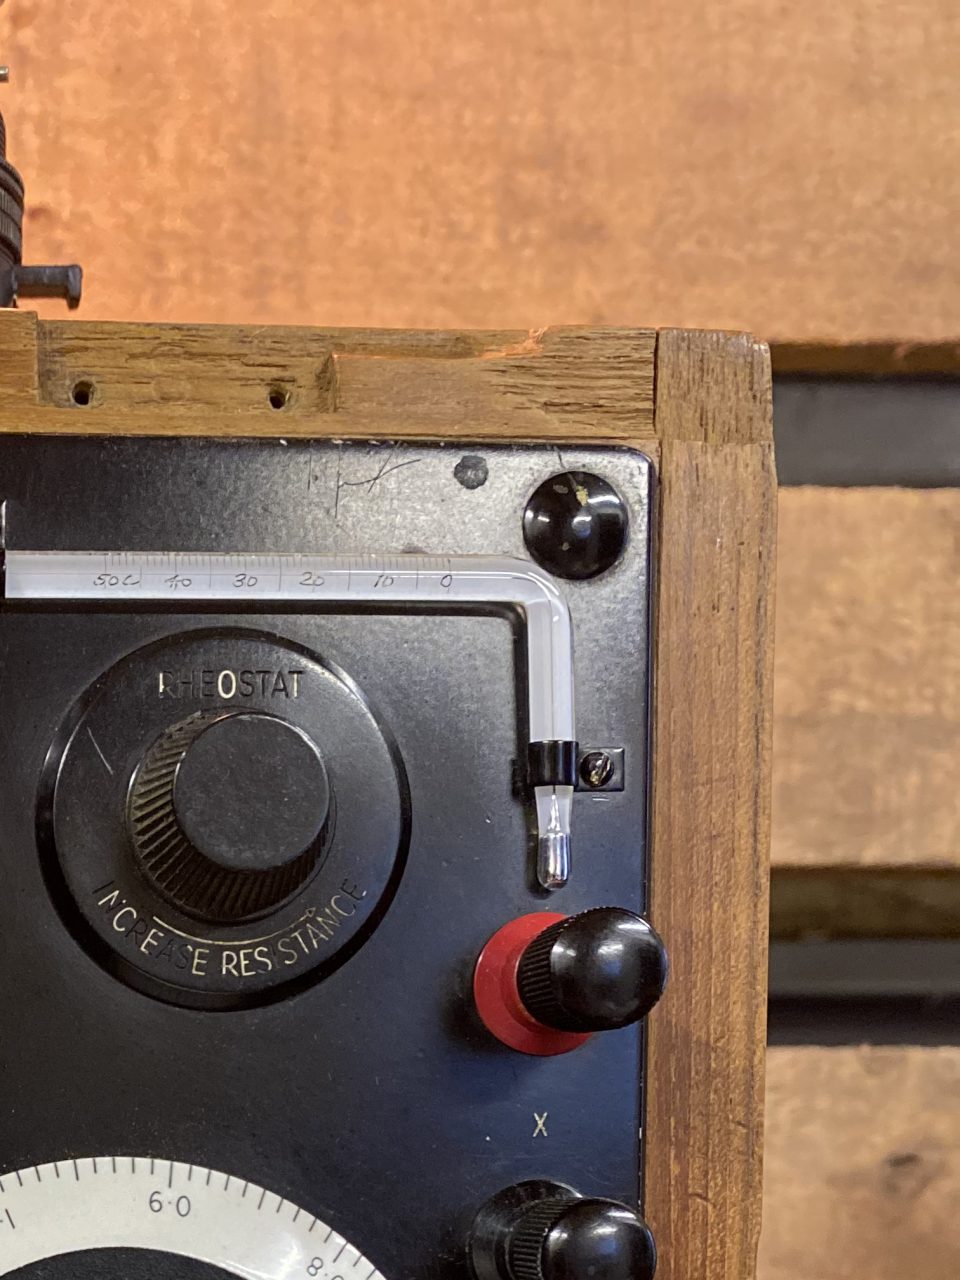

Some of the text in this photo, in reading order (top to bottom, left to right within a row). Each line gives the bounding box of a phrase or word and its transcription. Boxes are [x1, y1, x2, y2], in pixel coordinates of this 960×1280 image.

[232, 573, 258, 588] 30
[299, 571, 326, 588] 20
[158, 669, 306, 700] RHEOSTAT
[92, 878, 368, 978] INCREASE RESISTANCE
